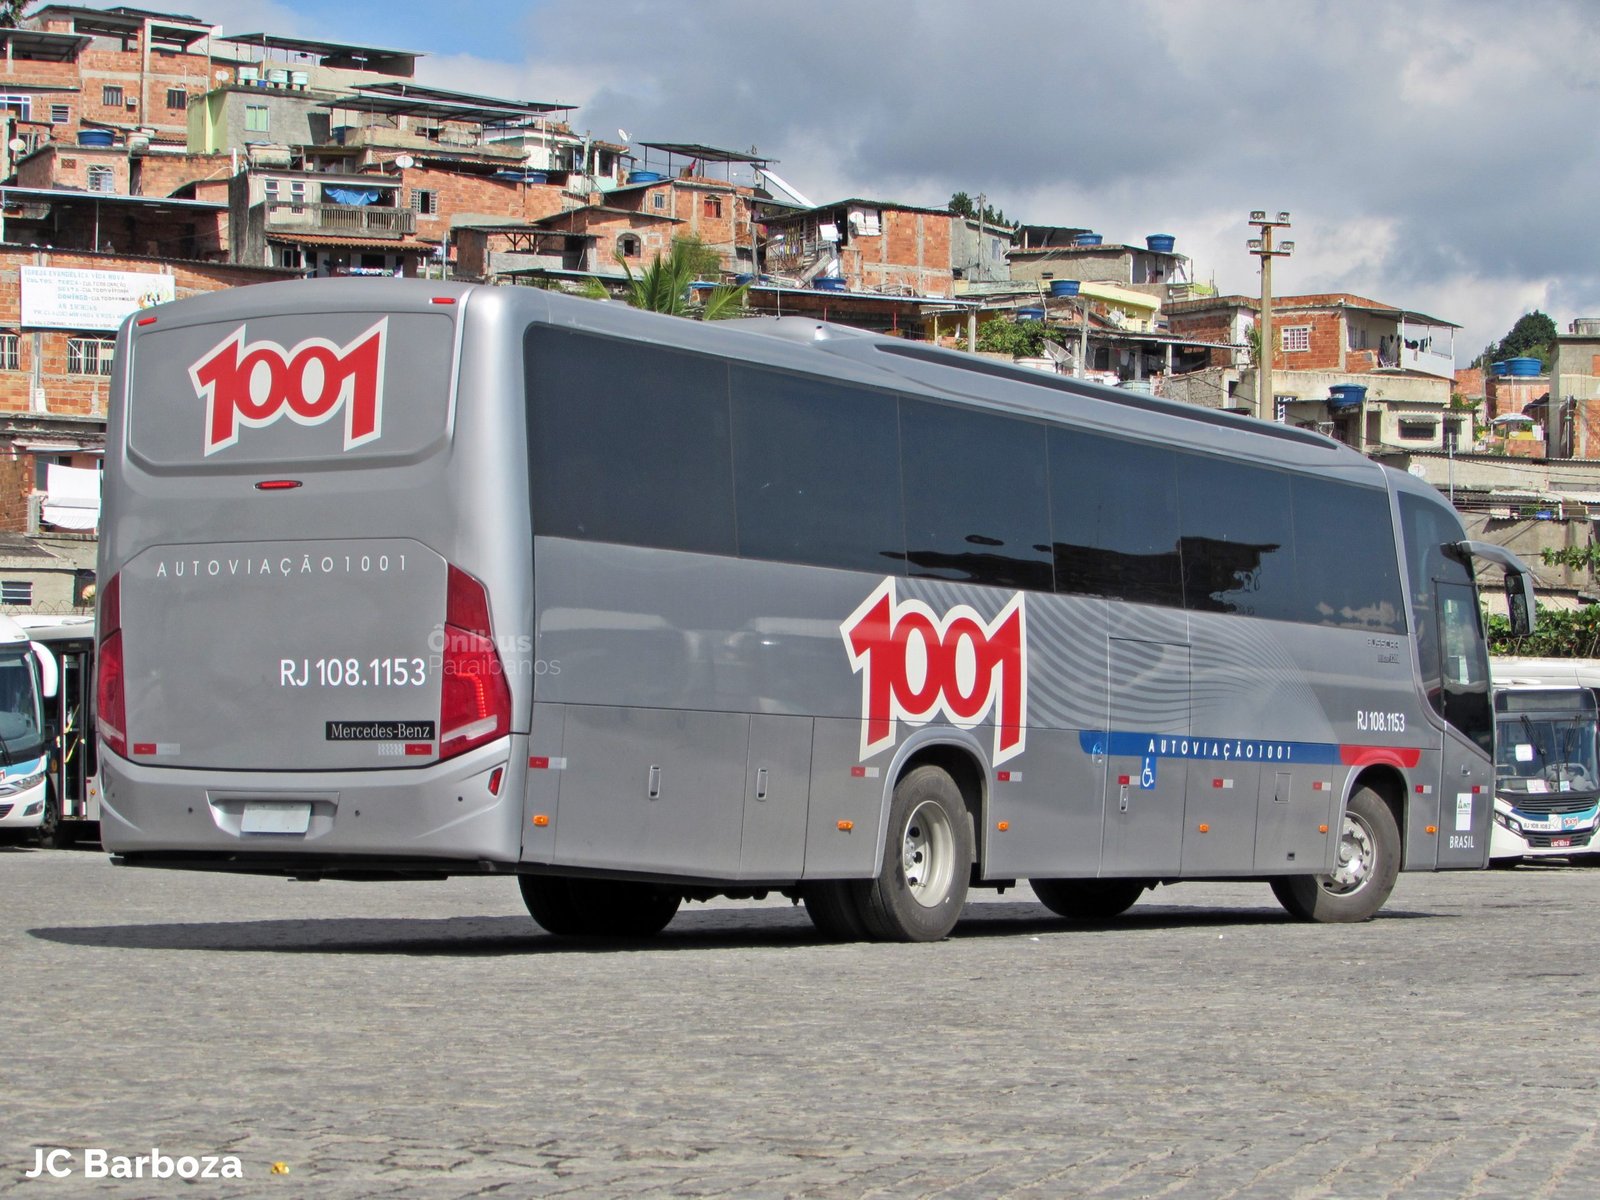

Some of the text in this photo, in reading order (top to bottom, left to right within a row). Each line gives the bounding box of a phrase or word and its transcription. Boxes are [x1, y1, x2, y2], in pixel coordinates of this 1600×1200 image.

[188, 315, 389, 457] 1001
[280, 657, 427, 687] RJ 108.1153
[839, 575, 1026, 766] 1001
[330, 723, 430, 739] Mercedes-Benz
[1357, 710, 1405, 733] RJ 108.1153
[1449, 836, 1475, 849] BRASIL
